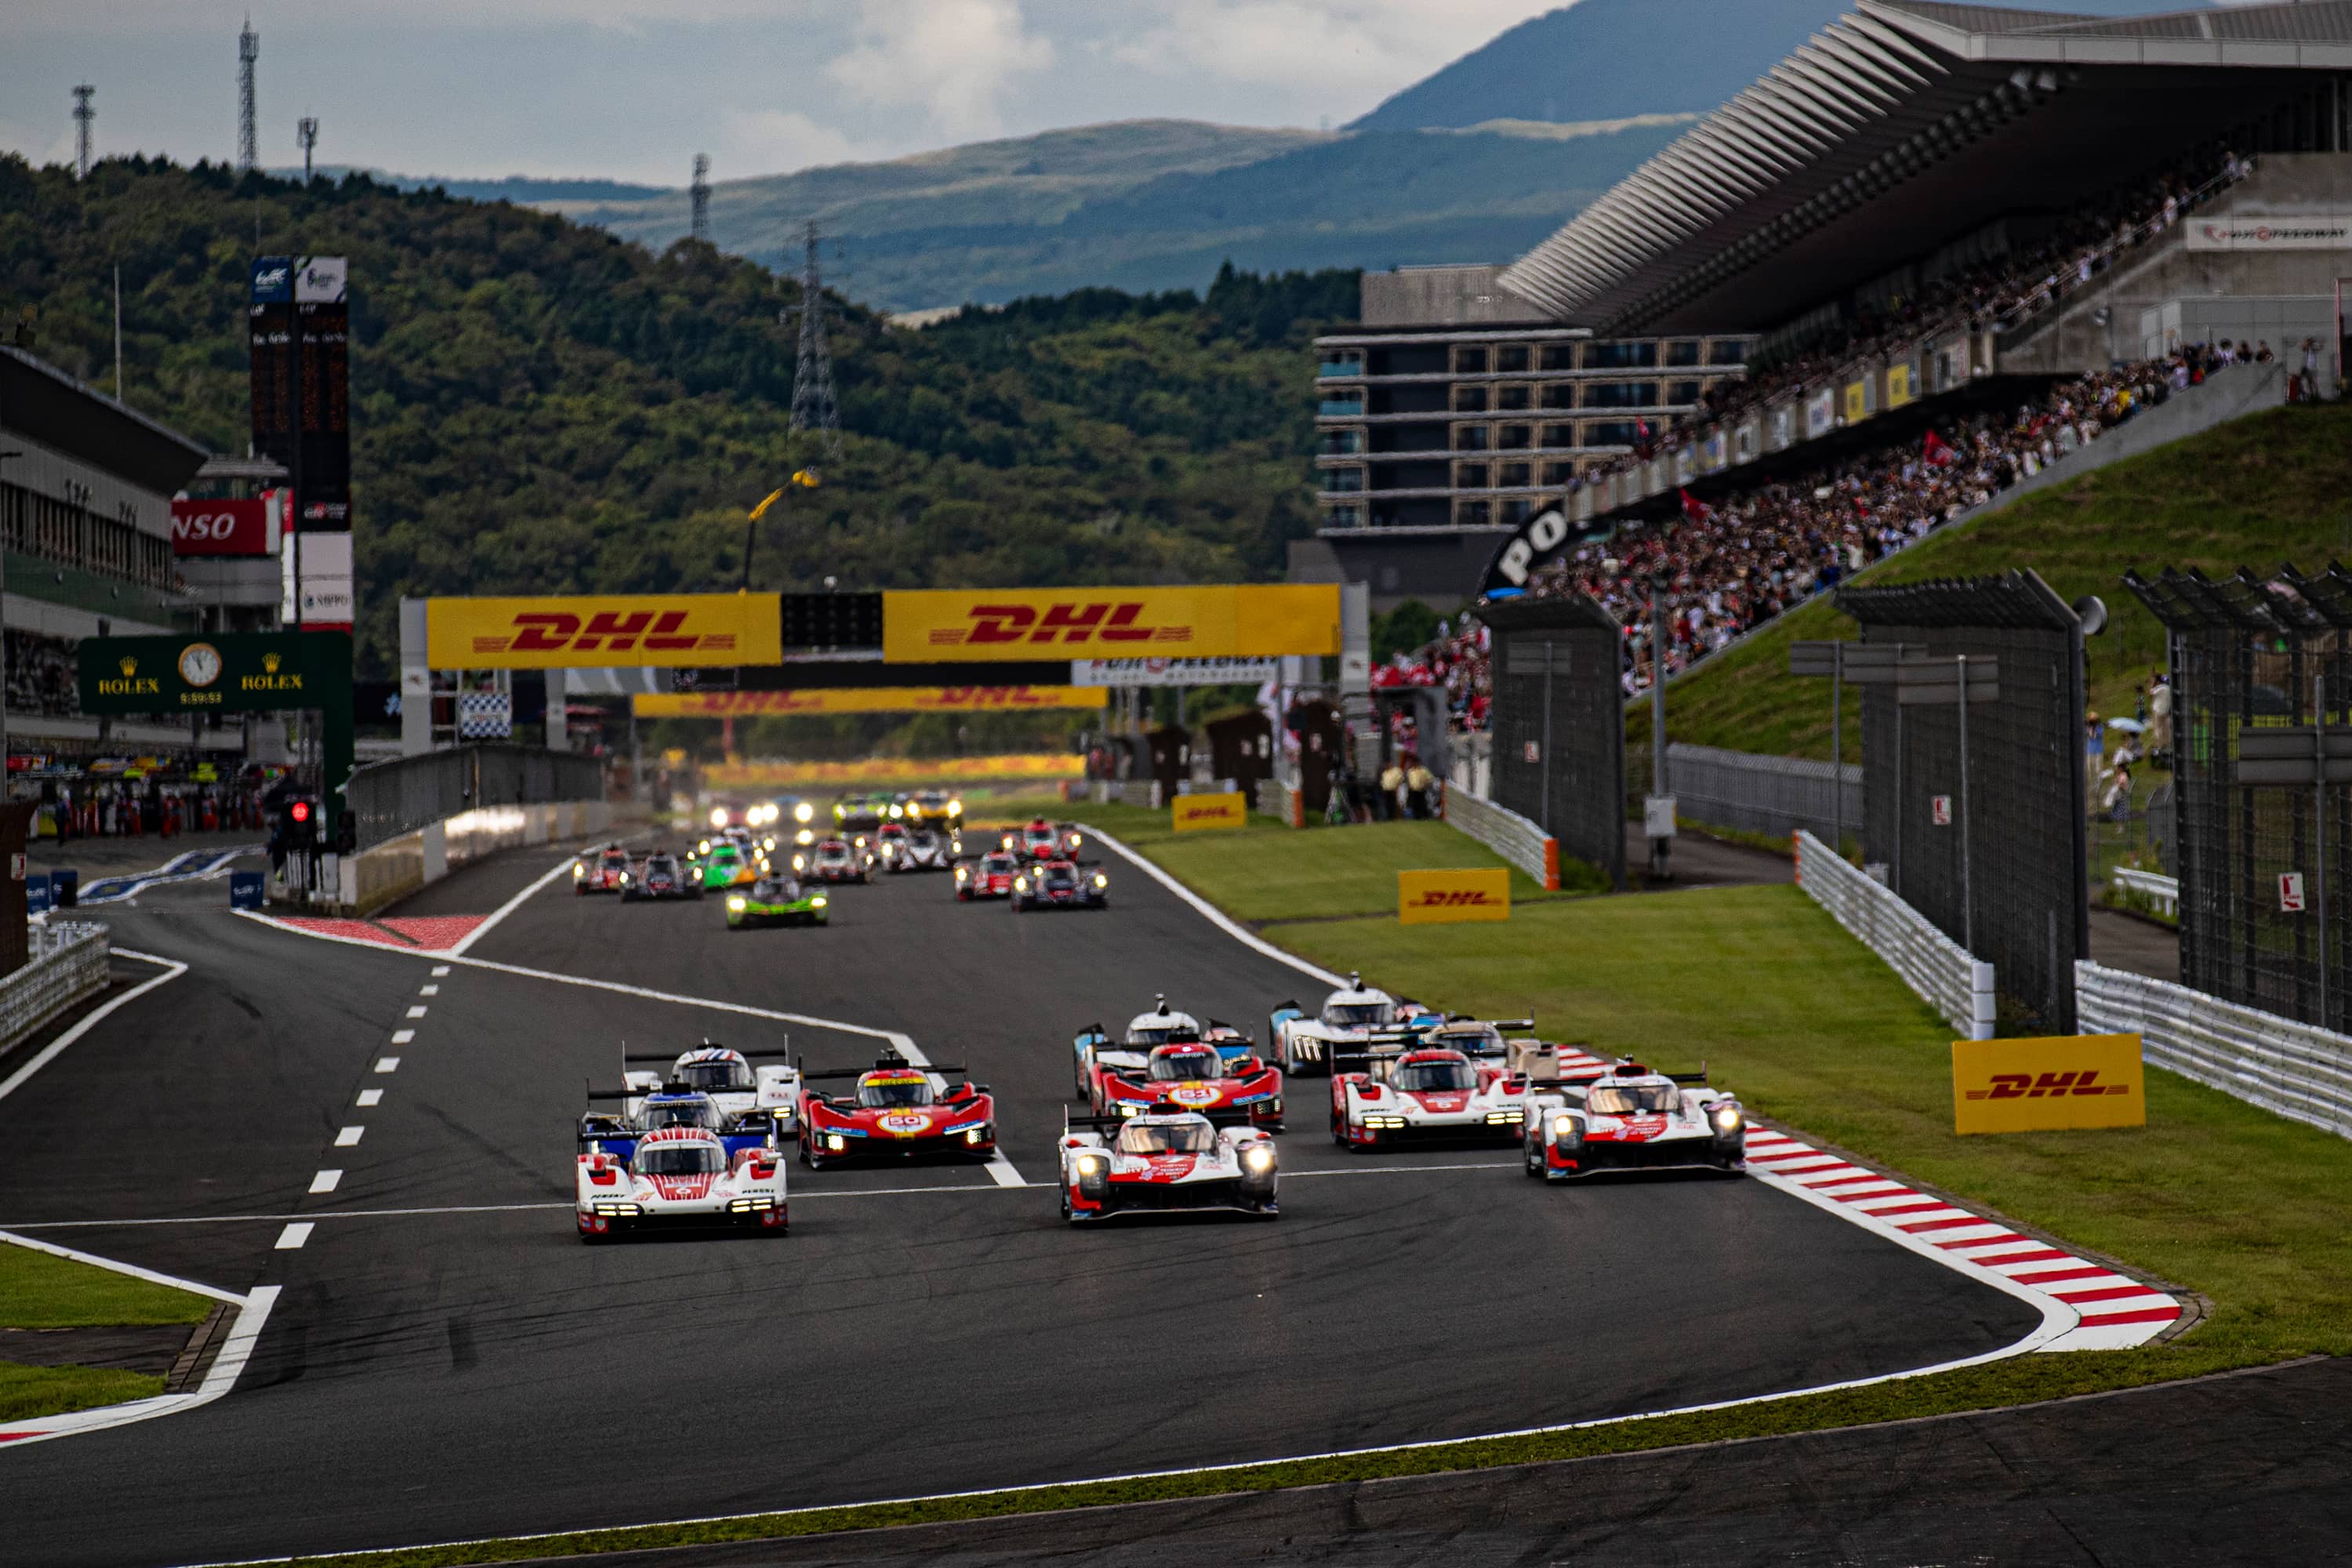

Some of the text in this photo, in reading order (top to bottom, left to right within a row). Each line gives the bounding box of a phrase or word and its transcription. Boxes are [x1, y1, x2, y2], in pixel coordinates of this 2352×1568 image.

[171, 513, 236, 540] NSO
[1498, 510, 1567, 586] PO
[510, 610, 700, 651] DHL
[964, 602, 1154, 643] DHL
[99, 677, 160, 695] ROLEX
[241, 673, 303, 691] ROLEX
[1422, 890, 1487, 907] DHL
[1987, 1070, 2107, 1098] DHL
[888, 1116, 921, 1126] 50
